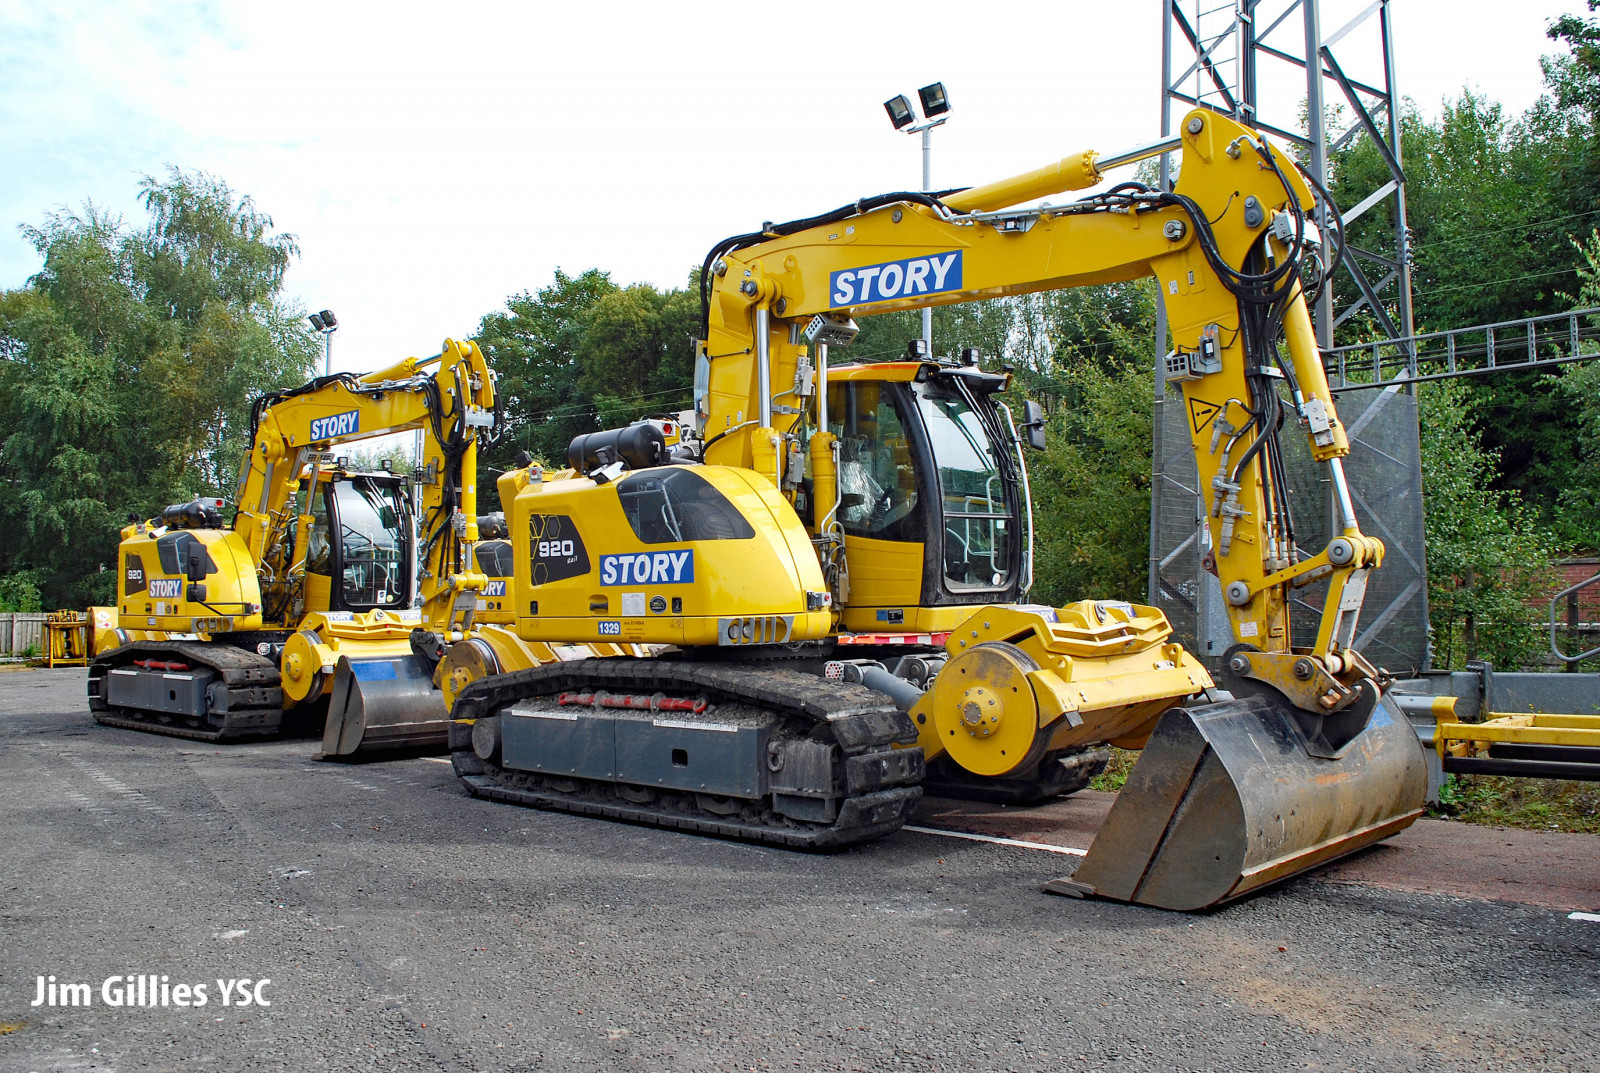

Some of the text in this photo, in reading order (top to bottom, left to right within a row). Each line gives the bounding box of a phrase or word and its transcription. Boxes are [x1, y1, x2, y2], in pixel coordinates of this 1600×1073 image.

[833, 253, 957, 305] STORY
[311, 411, 358, 440] STORY
[538, 539, 574, 557] 920
[128, 569, 142, 580] 920
[602, 551, 689, 584] STORY
[149, 580, 181, 597] STORY
[599, 622, 620, 634] 1329
